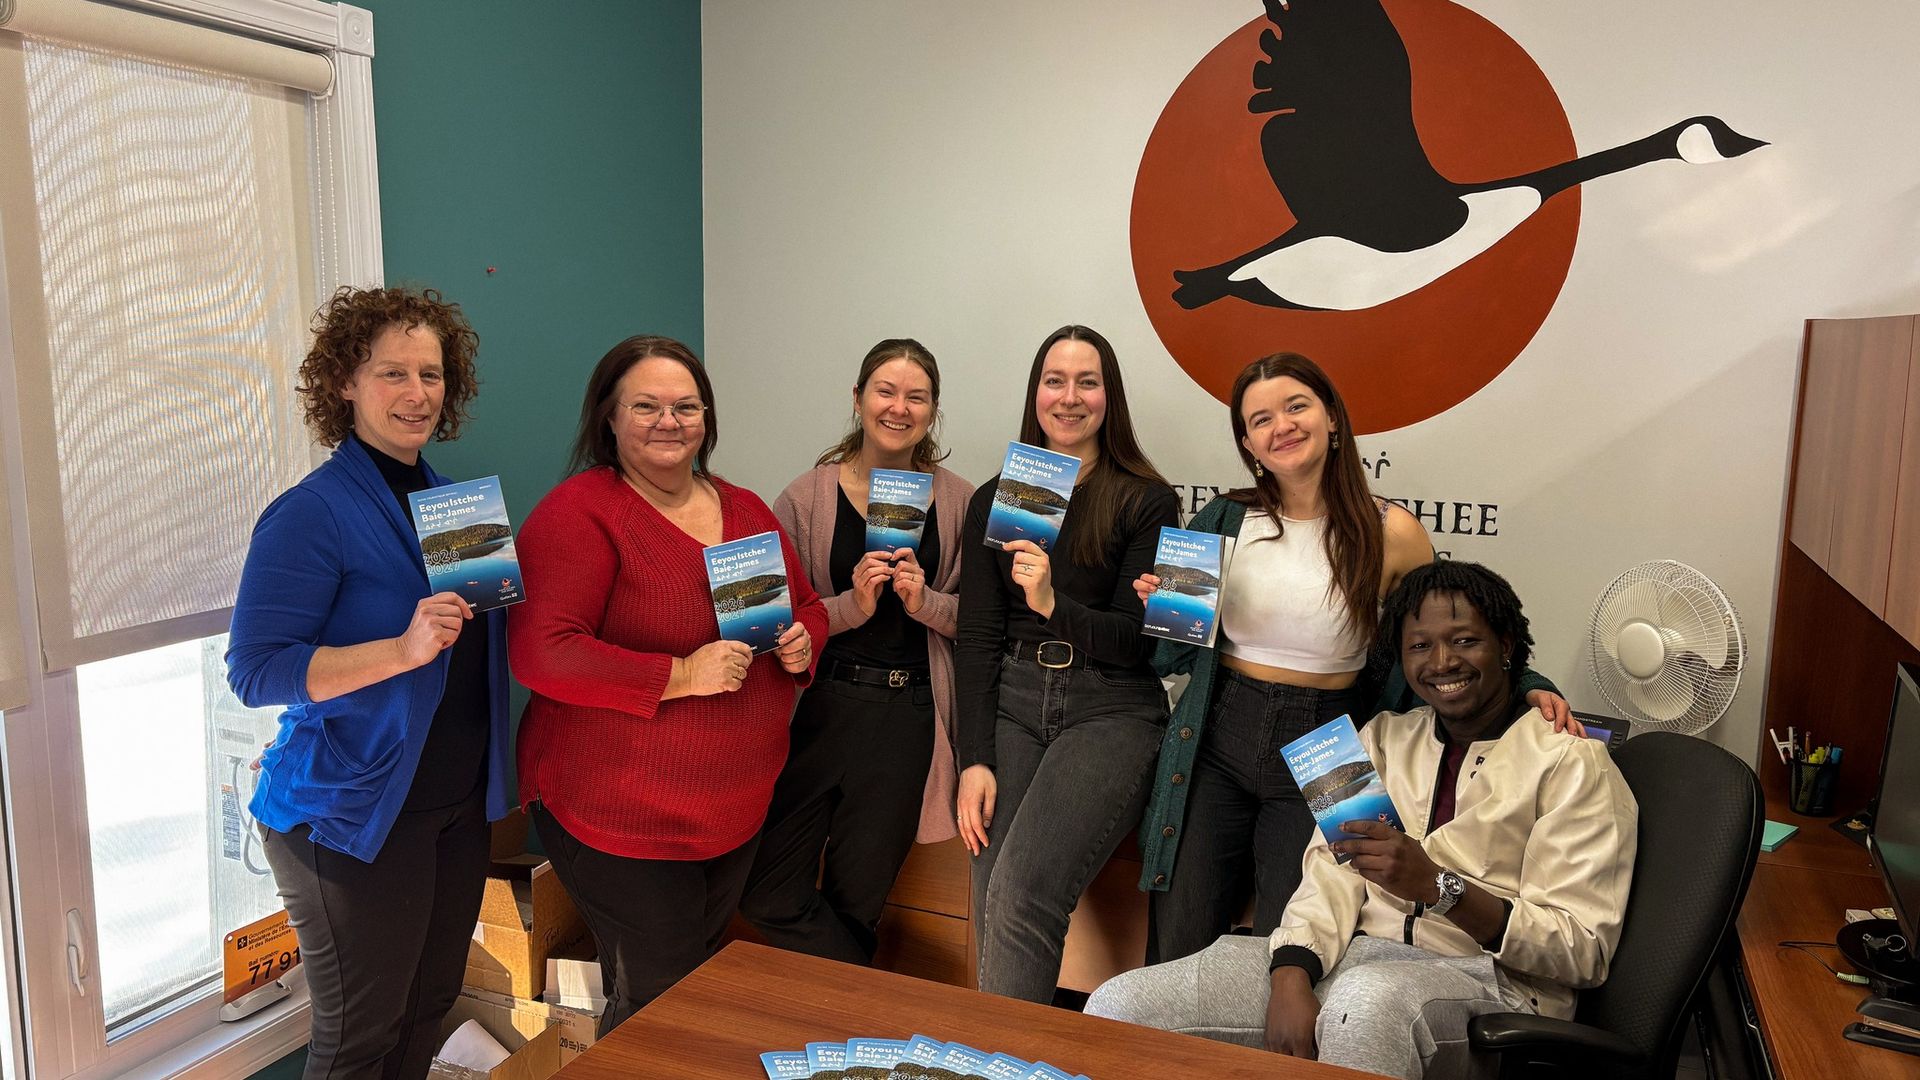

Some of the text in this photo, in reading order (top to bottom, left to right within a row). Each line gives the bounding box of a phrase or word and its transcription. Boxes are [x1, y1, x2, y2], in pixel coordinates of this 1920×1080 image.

[1009, 461, 1052, 479] Baie-James
[1011, 453, 1035, 466] Eeyou
[1035, 460, 1063, 473] Istchee
[873, 485, 912, 496] Baie-James
[874, 477, 920, 489] Eeyou Istchee
[418, 501, 449, 513] Eeyou
[449, 494, 485, 507] Istchee
[421, 505, 477, 523] Baie-James
[1161, 545, 1198, 558] Baie-James
[1162, 537, 1206, 552] Eeyou Istchee
[422, 547, 460, 565] 2026
[711, 555, 737, 566] Eeyou
[737, 548, 767, 560] Istchee
[425, 559, 461, 577] 2027
[713, 559, 760, 575] Baie-James
[714, 597, 745, 612] 2026
[716, 607, 746, 624] 2027
[1288, 750, 1311, 765] Eeyou
[1310, 734, 1340, 753] Istchee
[1293, 749, 1335, 773] Baie-James
[248, 920, 284, 939] Gouvernement
[265, 929, 291, 944] Ressources
[248, 932, 271, 945] Ministère
[248, 958, 258, 967] Bail
